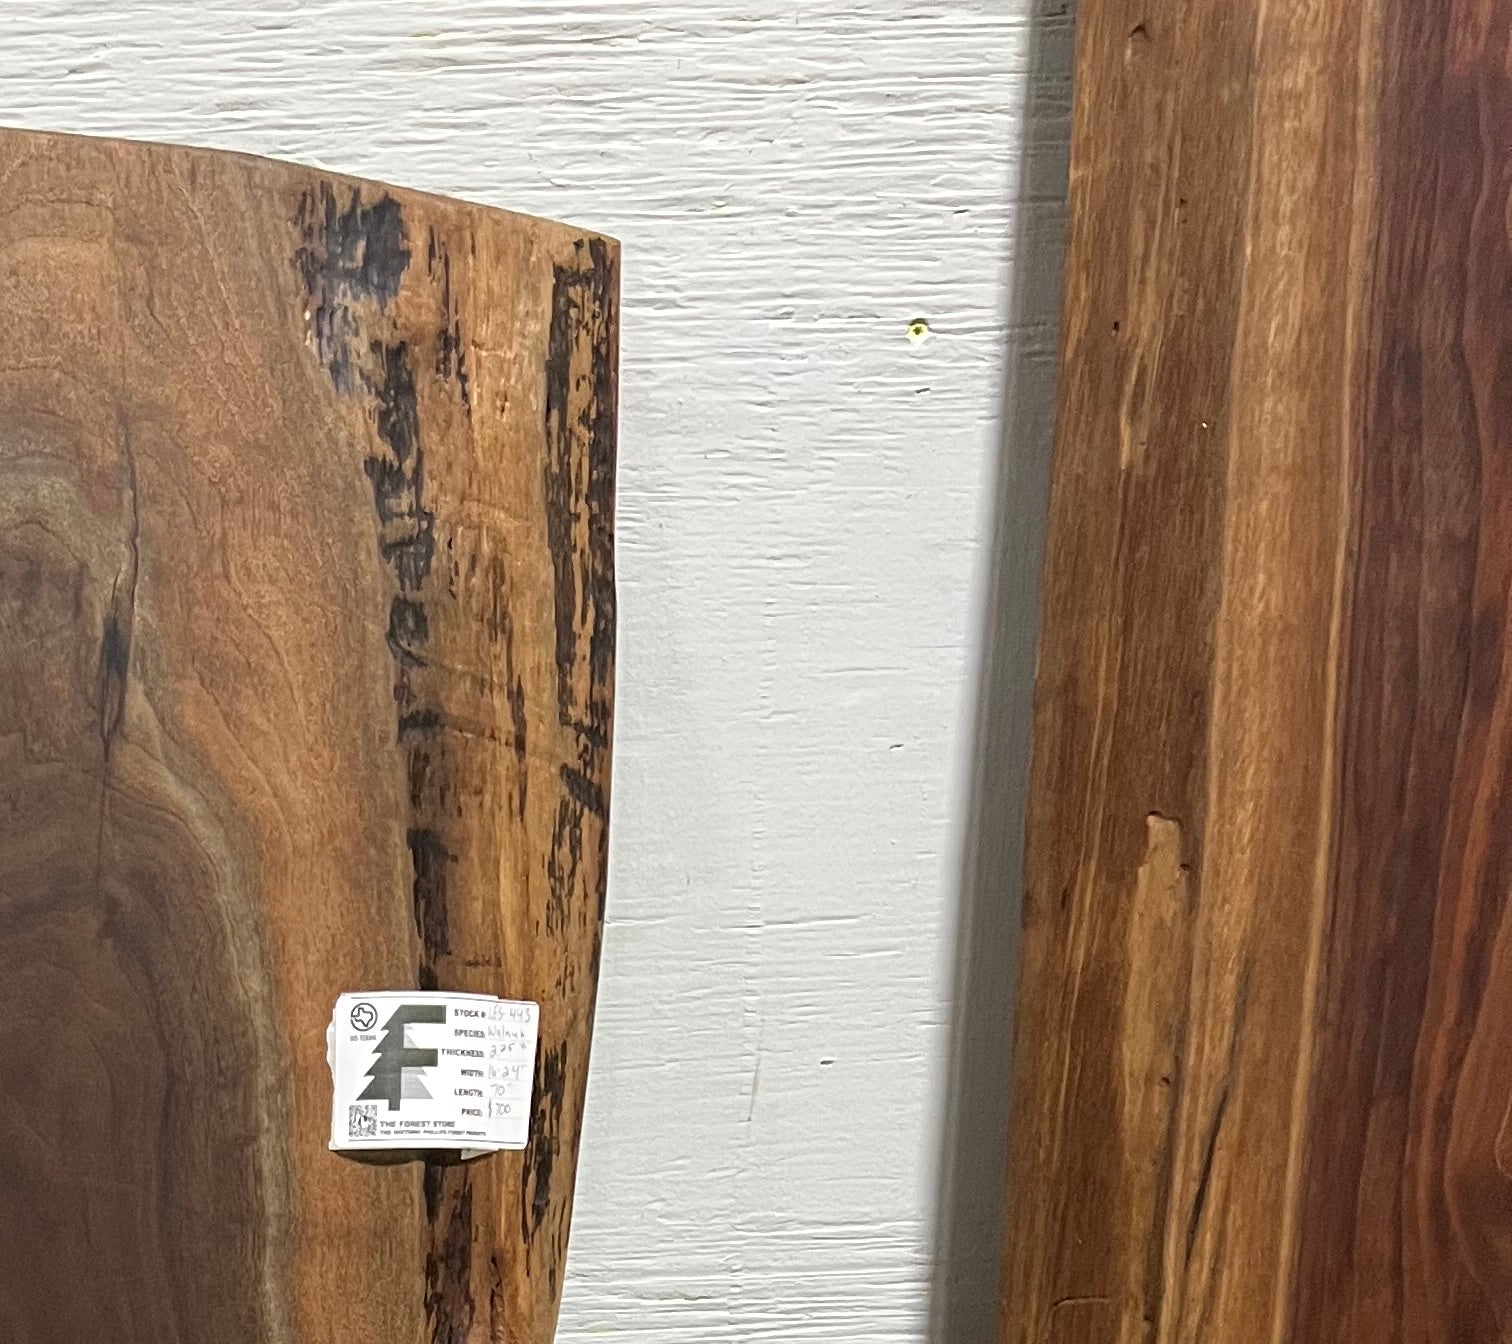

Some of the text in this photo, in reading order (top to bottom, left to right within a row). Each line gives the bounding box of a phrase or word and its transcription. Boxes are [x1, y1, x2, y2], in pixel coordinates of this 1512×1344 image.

[380, 1120, 456, 1128] THE FOREST STORE
